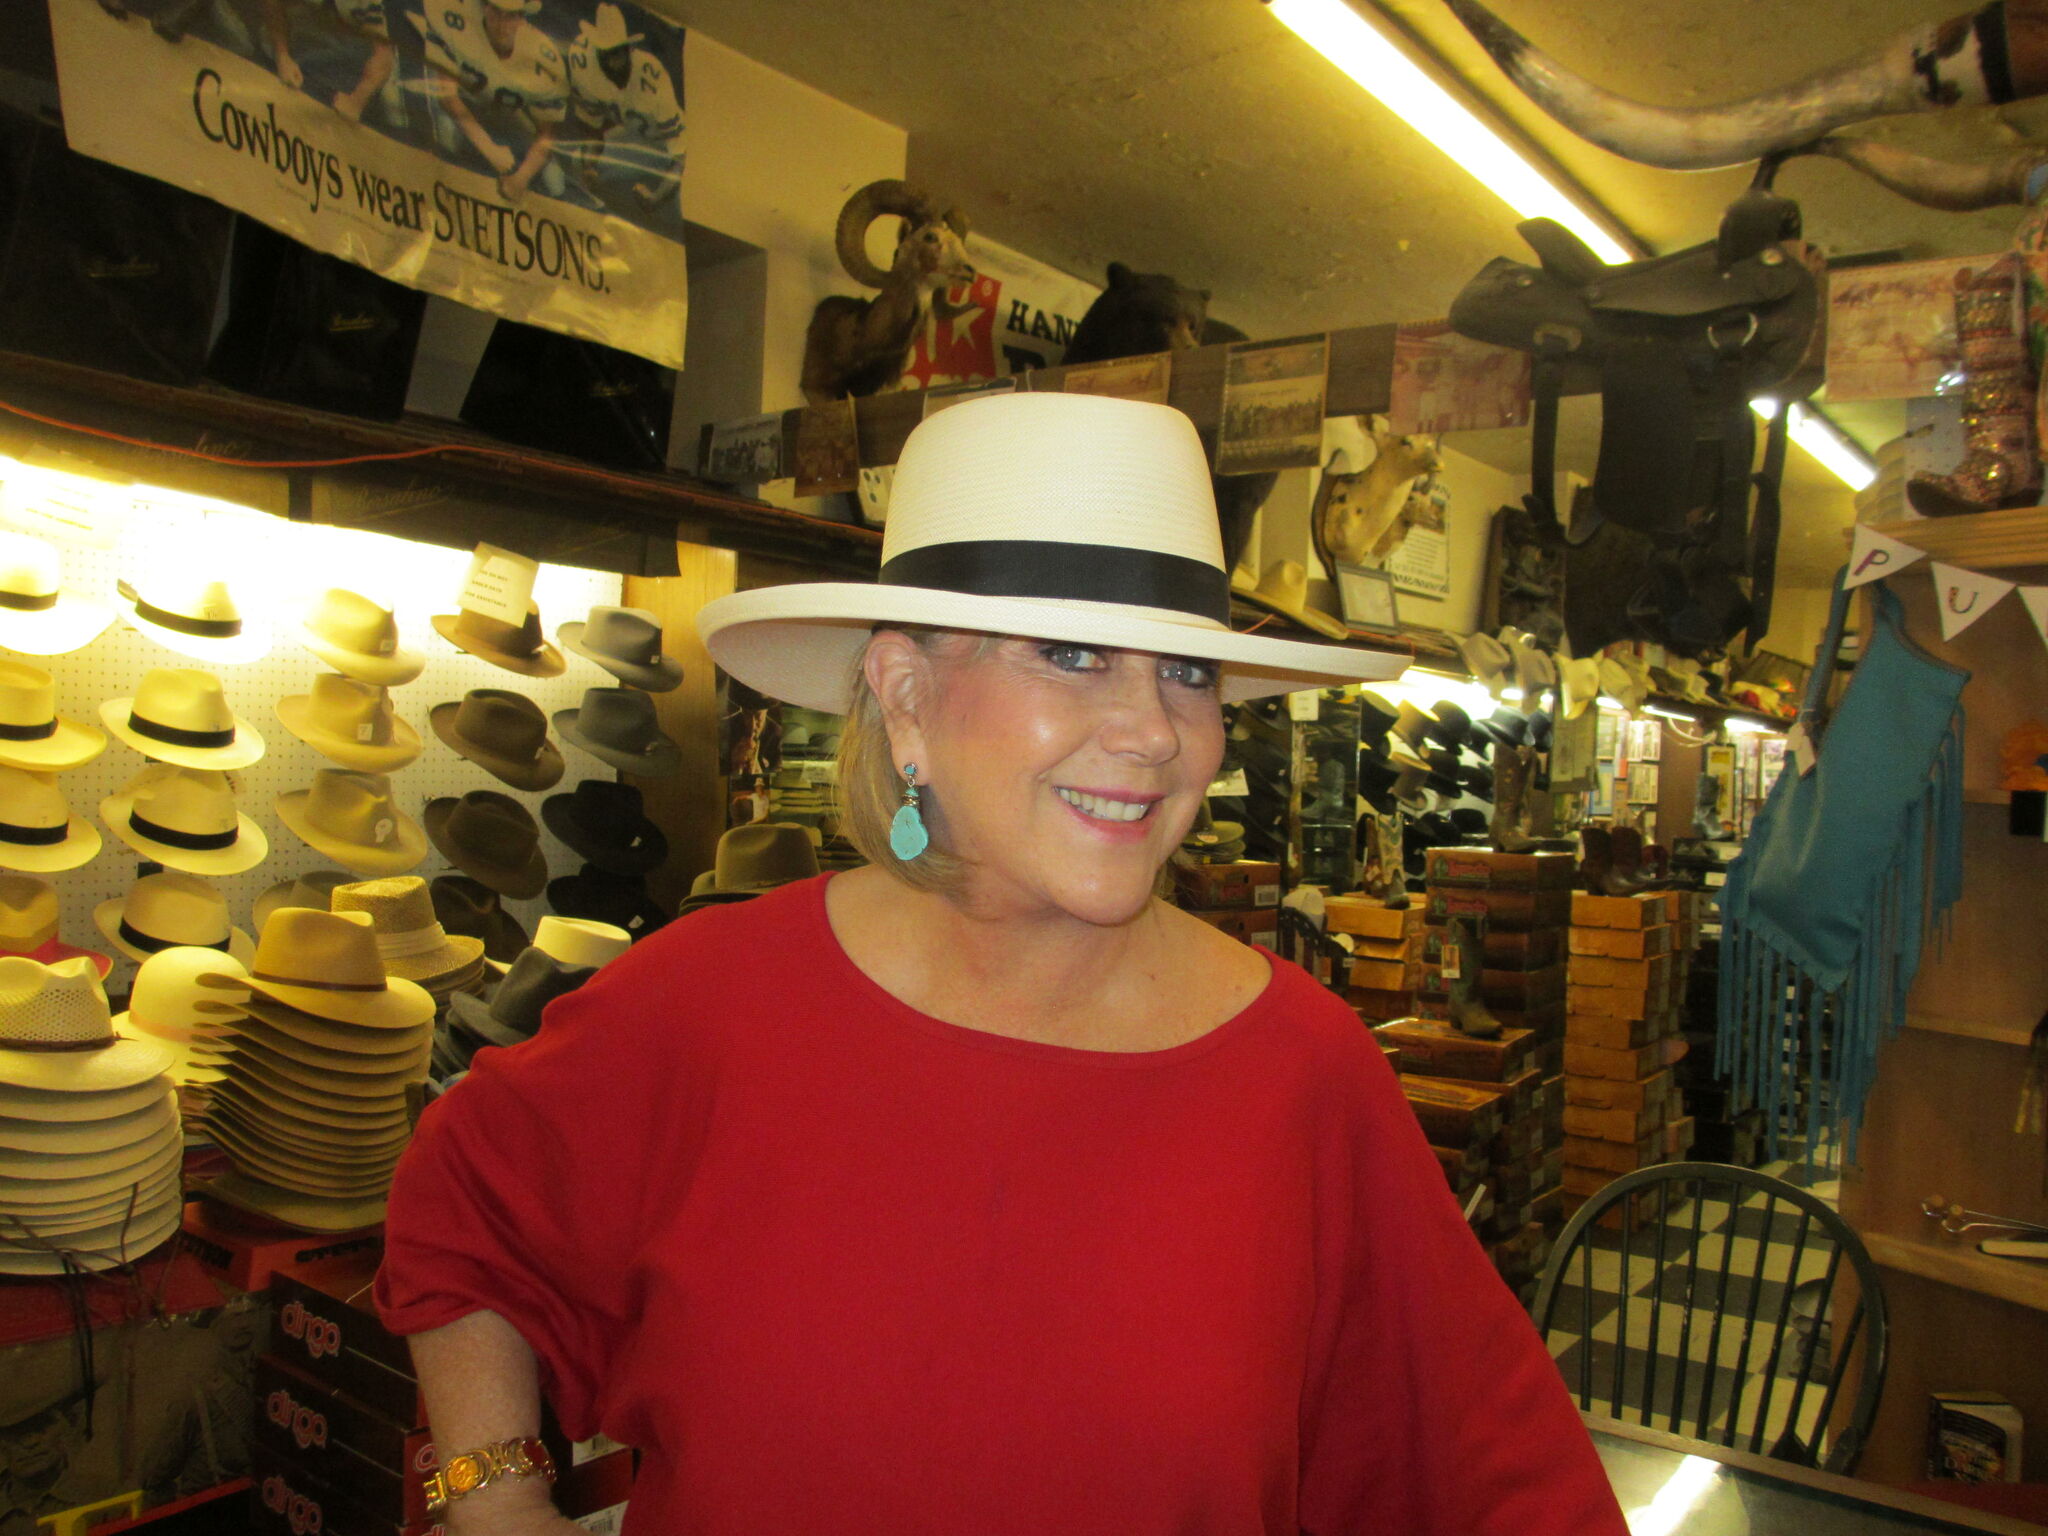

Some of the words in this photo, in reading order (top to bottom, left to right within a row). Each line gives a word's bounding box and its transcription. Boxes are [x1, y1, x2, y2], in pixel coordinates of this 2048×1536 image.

[193, 68, 343, 213] Cowboys
[349, 164, 425, 231] wear
[433, 181, 611, 294] STETSONS.
[1006, 298, 1080, 347] HAN
[1853, 548, 1890, 576] P
[1948, 585, 1979, 614] U
[280, 1299, 341, 1359] dingo
[265, 1389, 328, 1449] dingo
[261, 1474, 323, 1536] dingo
